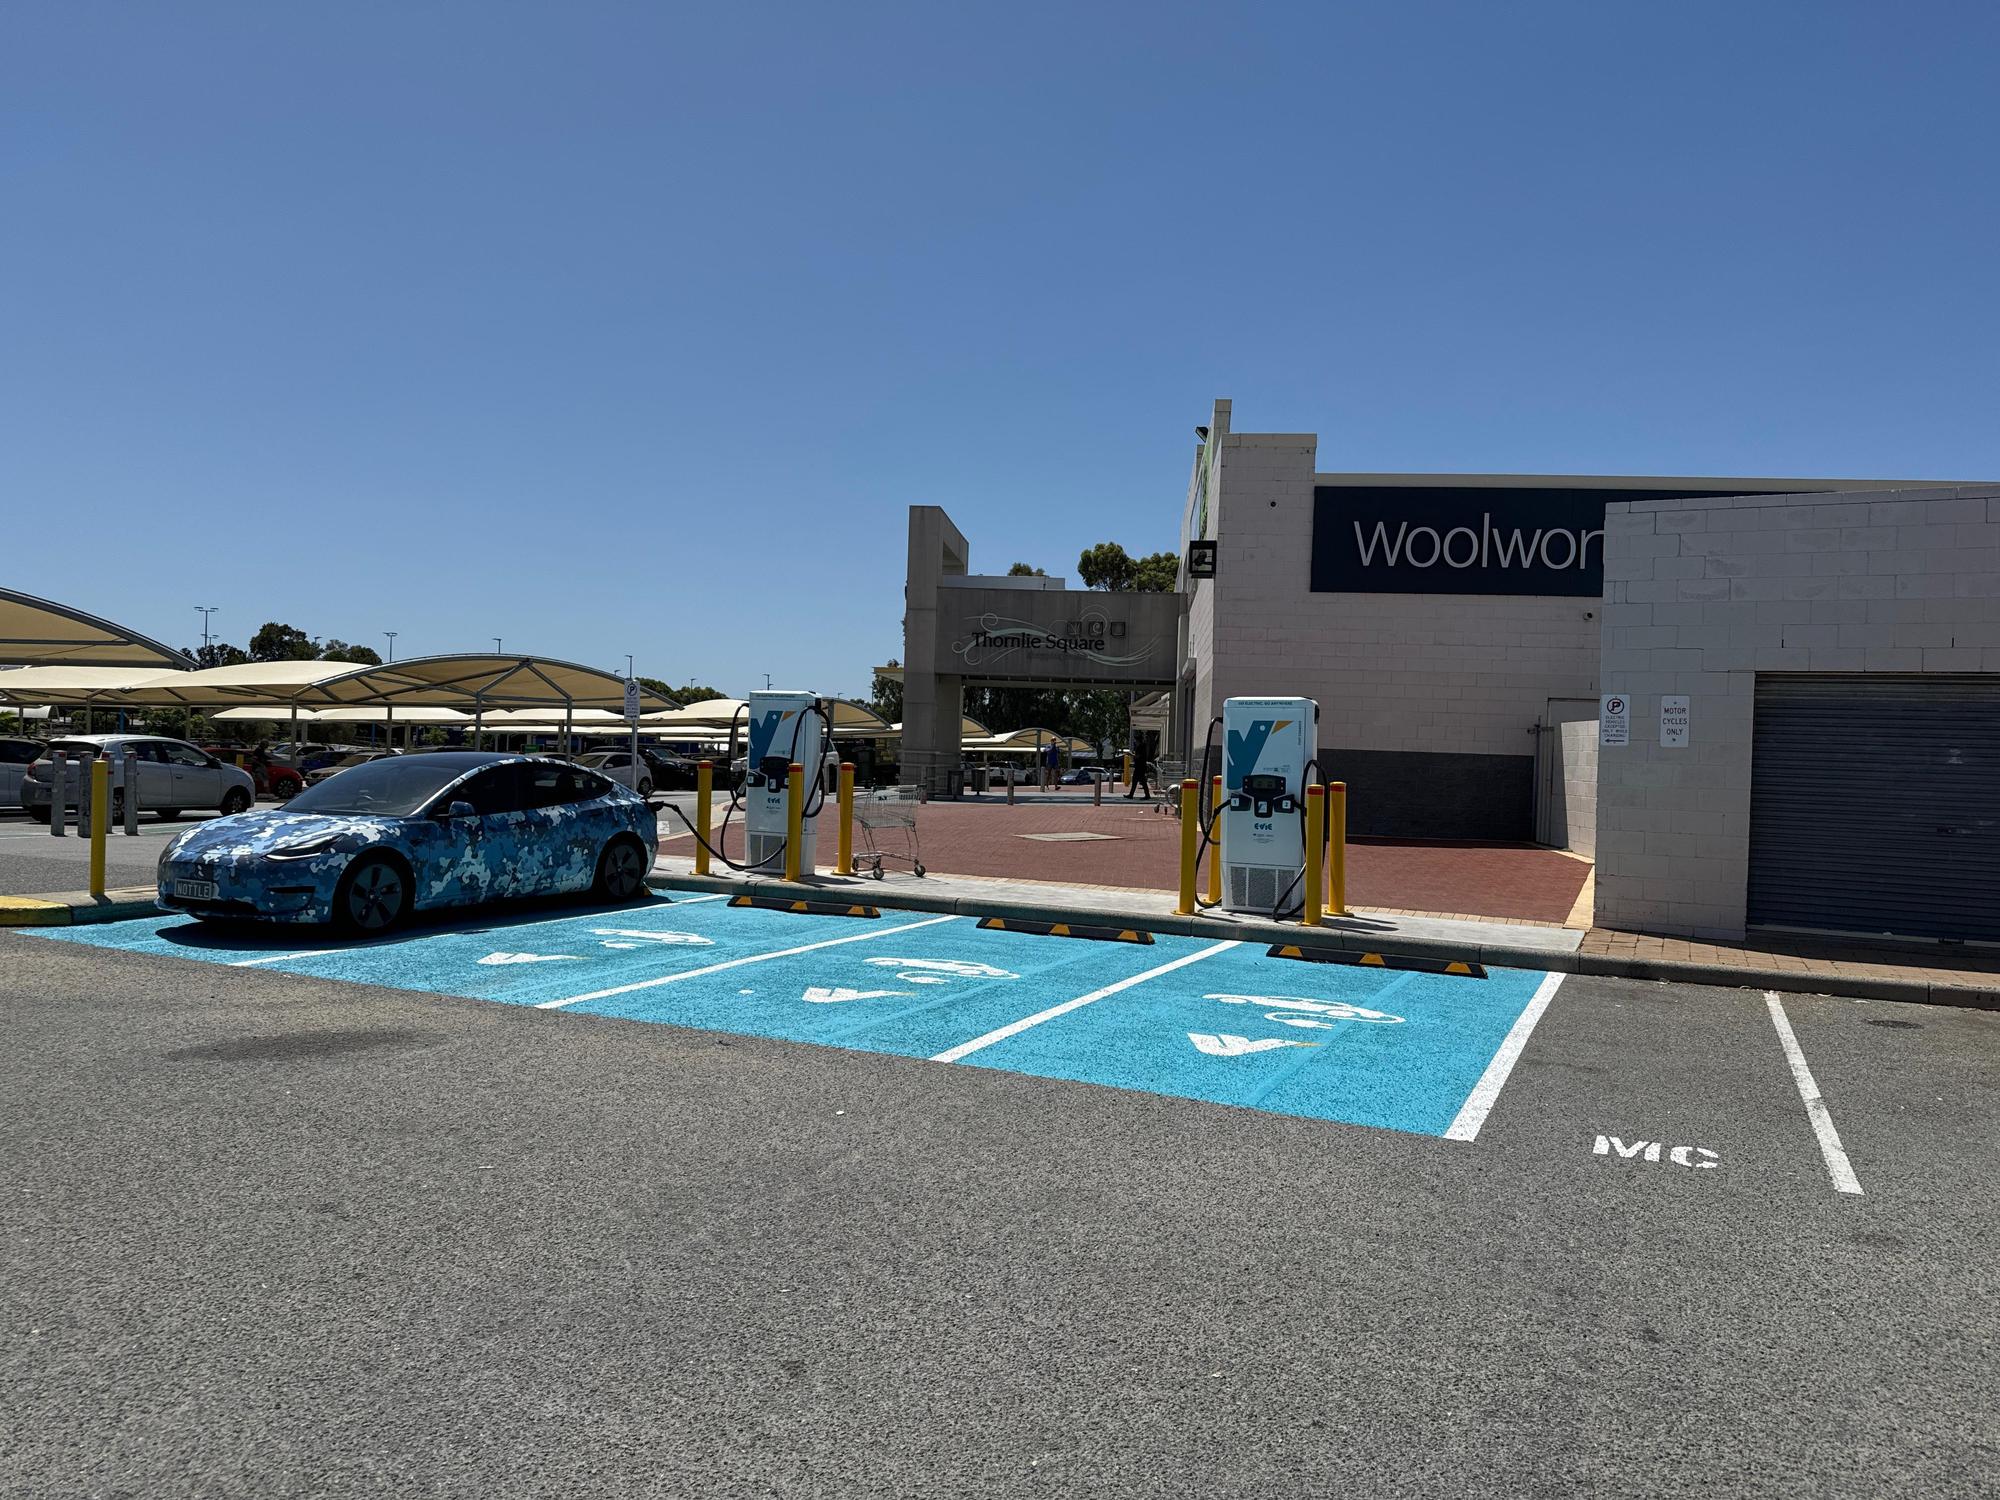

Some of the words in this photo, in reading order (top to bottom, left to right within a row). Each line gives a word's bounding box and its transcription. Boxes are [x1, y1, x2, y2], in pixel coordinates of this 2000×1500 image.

[1353, 512, 1605, 570] Woolwor
[971, 631, 1041, 650] Thornlie
[1045, 634, 1105, 652] Square
[1663, 707, 1687, 715] MOTOR
[1666, 728, 1684, 736] ONLY
[177, 882, 210, 898] NOTTLE
[1592, 1134, 1719, 1169] MC
